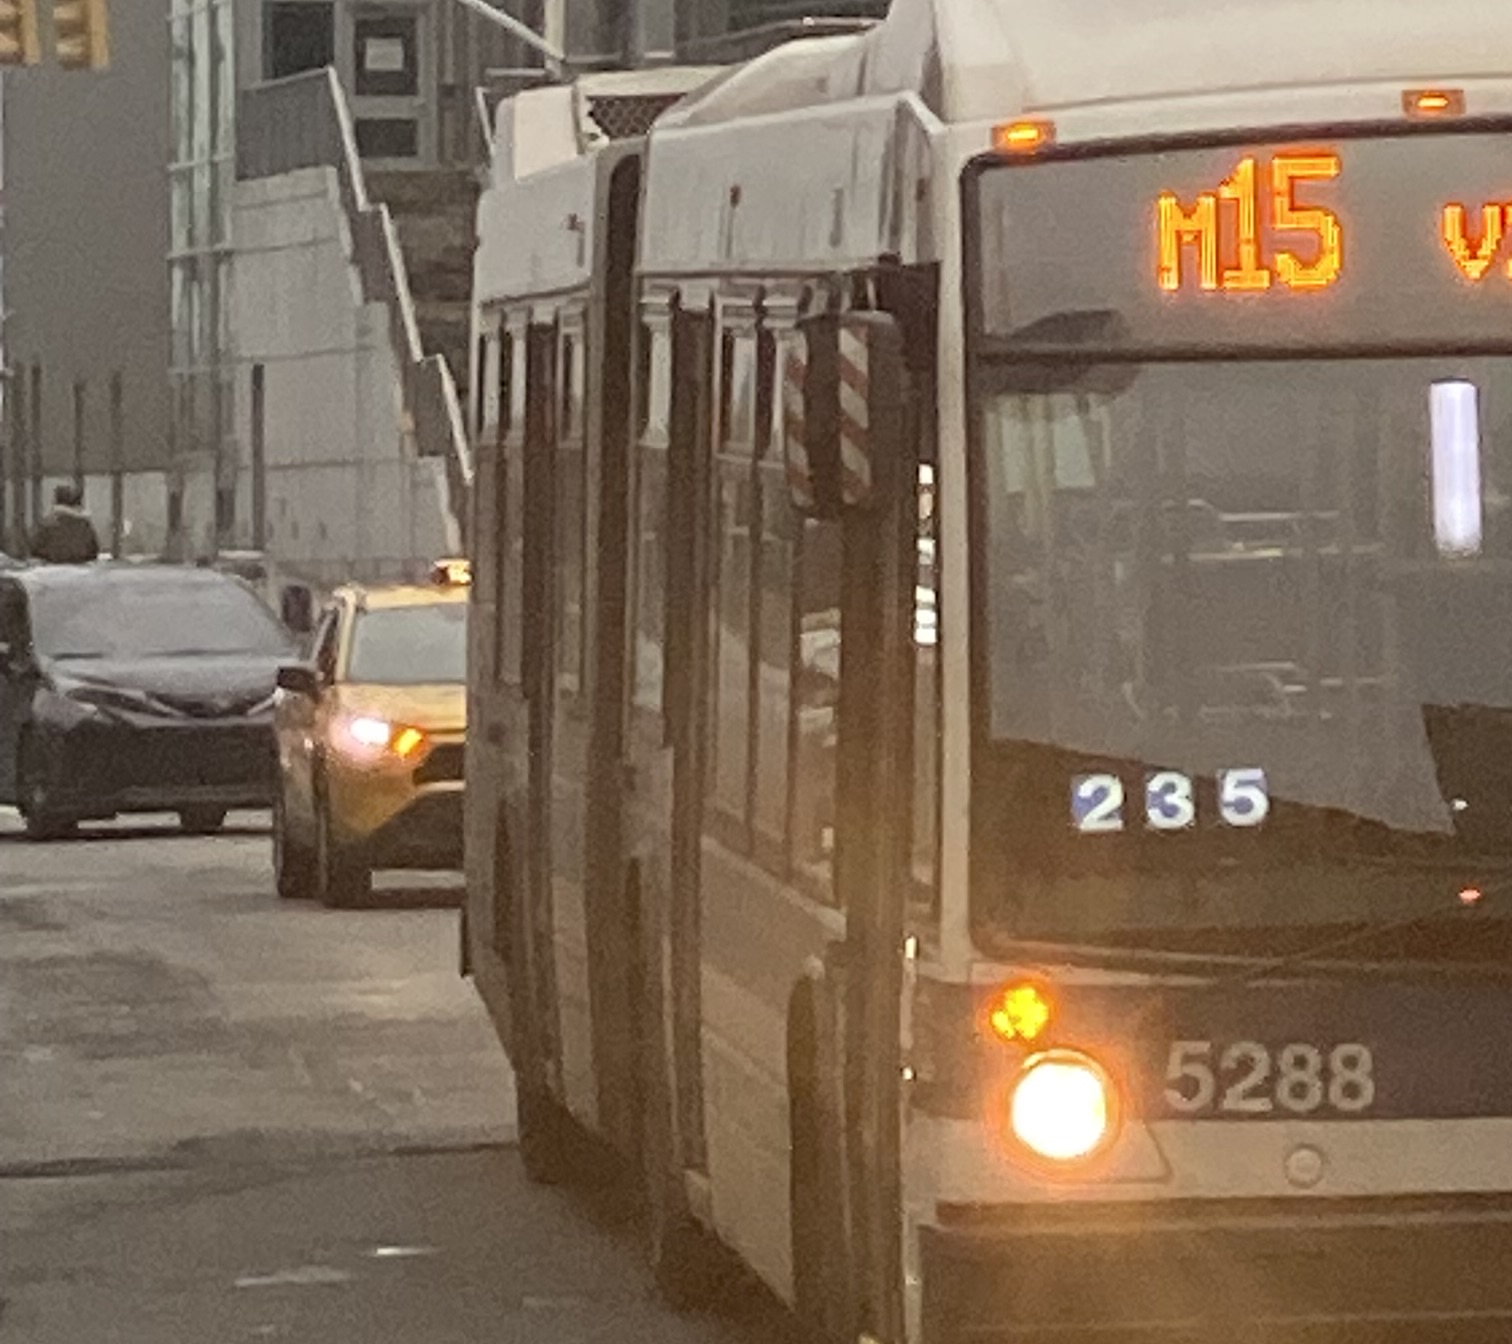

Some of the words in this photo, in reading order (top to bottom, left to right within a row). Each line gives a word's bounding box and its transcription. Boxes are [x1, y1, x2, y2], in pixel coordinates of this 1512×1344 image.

[1157, 147, 1343, 292] M15
[1074, 767, 1270, 832] 235
[1163, 1039, 1377, 1113] 5288
